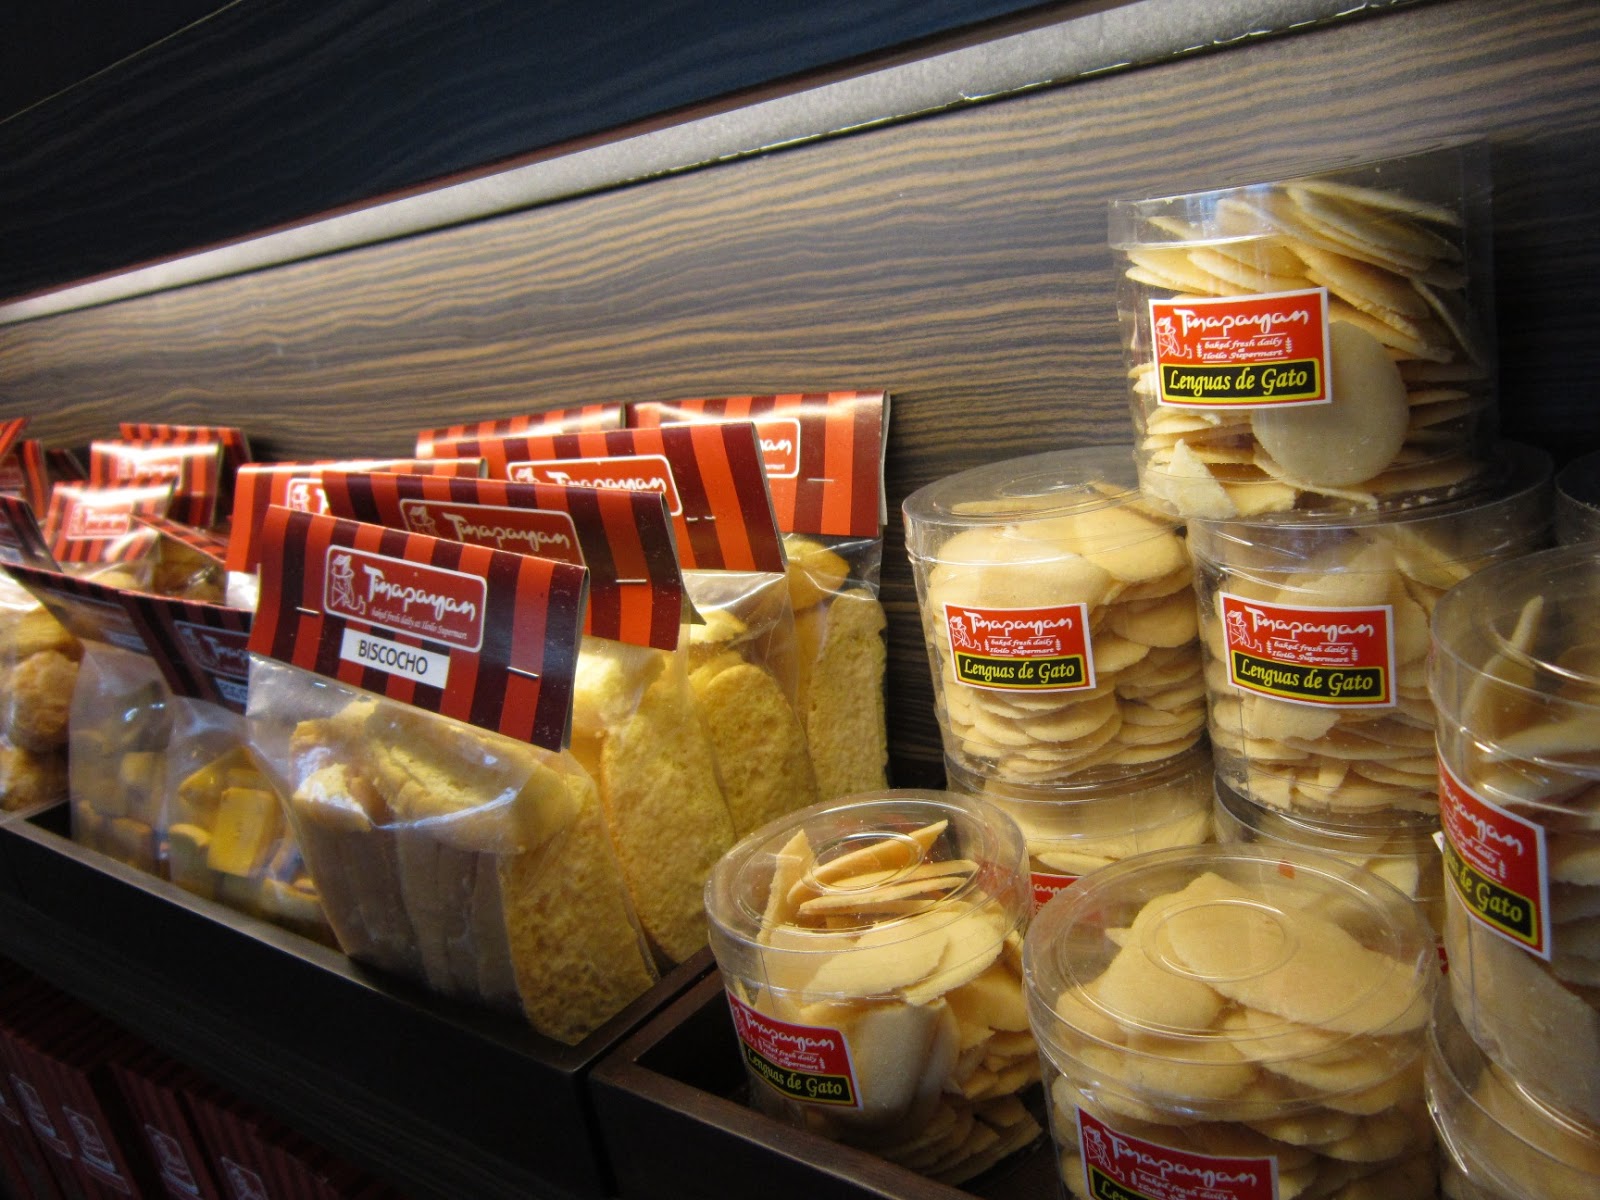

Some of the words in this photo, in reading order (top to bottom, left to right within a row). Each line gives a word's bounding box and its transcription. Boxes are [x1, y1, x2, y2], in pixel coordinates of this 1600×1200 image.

[1173, 308, 1309, 337] Tinapayan
[1204, 340, 1230, 349] baked
[1230, 339, 1255, 349] fresh
[1257, 337, 1282, 347] daily
[1228, 350, 1283, 360] Supermart
[1169, 370, 1231, 396] Lenguas
[1235, 367, 1255, 390] de
[1261, 368, 1308, 395] Gato
[441, 512, 570, 552] Tinapayan
[363, 563, 476, 622] Tinapayan
[963, 610, 1073, 636] Tinapayan
[1244, 605, 1374, 643] Tinapayan
[358, 639, 428, 675] BISCOCHO
[964, 659, 1014, 682] Lenguas
[1018, 662, 1034, 679] de
[1038, 663, 1075, 684] Gato
[1241, 659, 1299, 687] Lenguas
[1304, 669, 1322, 689] de
[1328, 672, 1374, 696] Gato
[1476, 883, 1523, 922] Gato
[748, 1049, 784, 1085] Lenguas
[787, 1073, 801, 1089] de
[806, 1078, 842, 1097] Gato
[1103, 1127, 1257, 1188] Tinapayan
